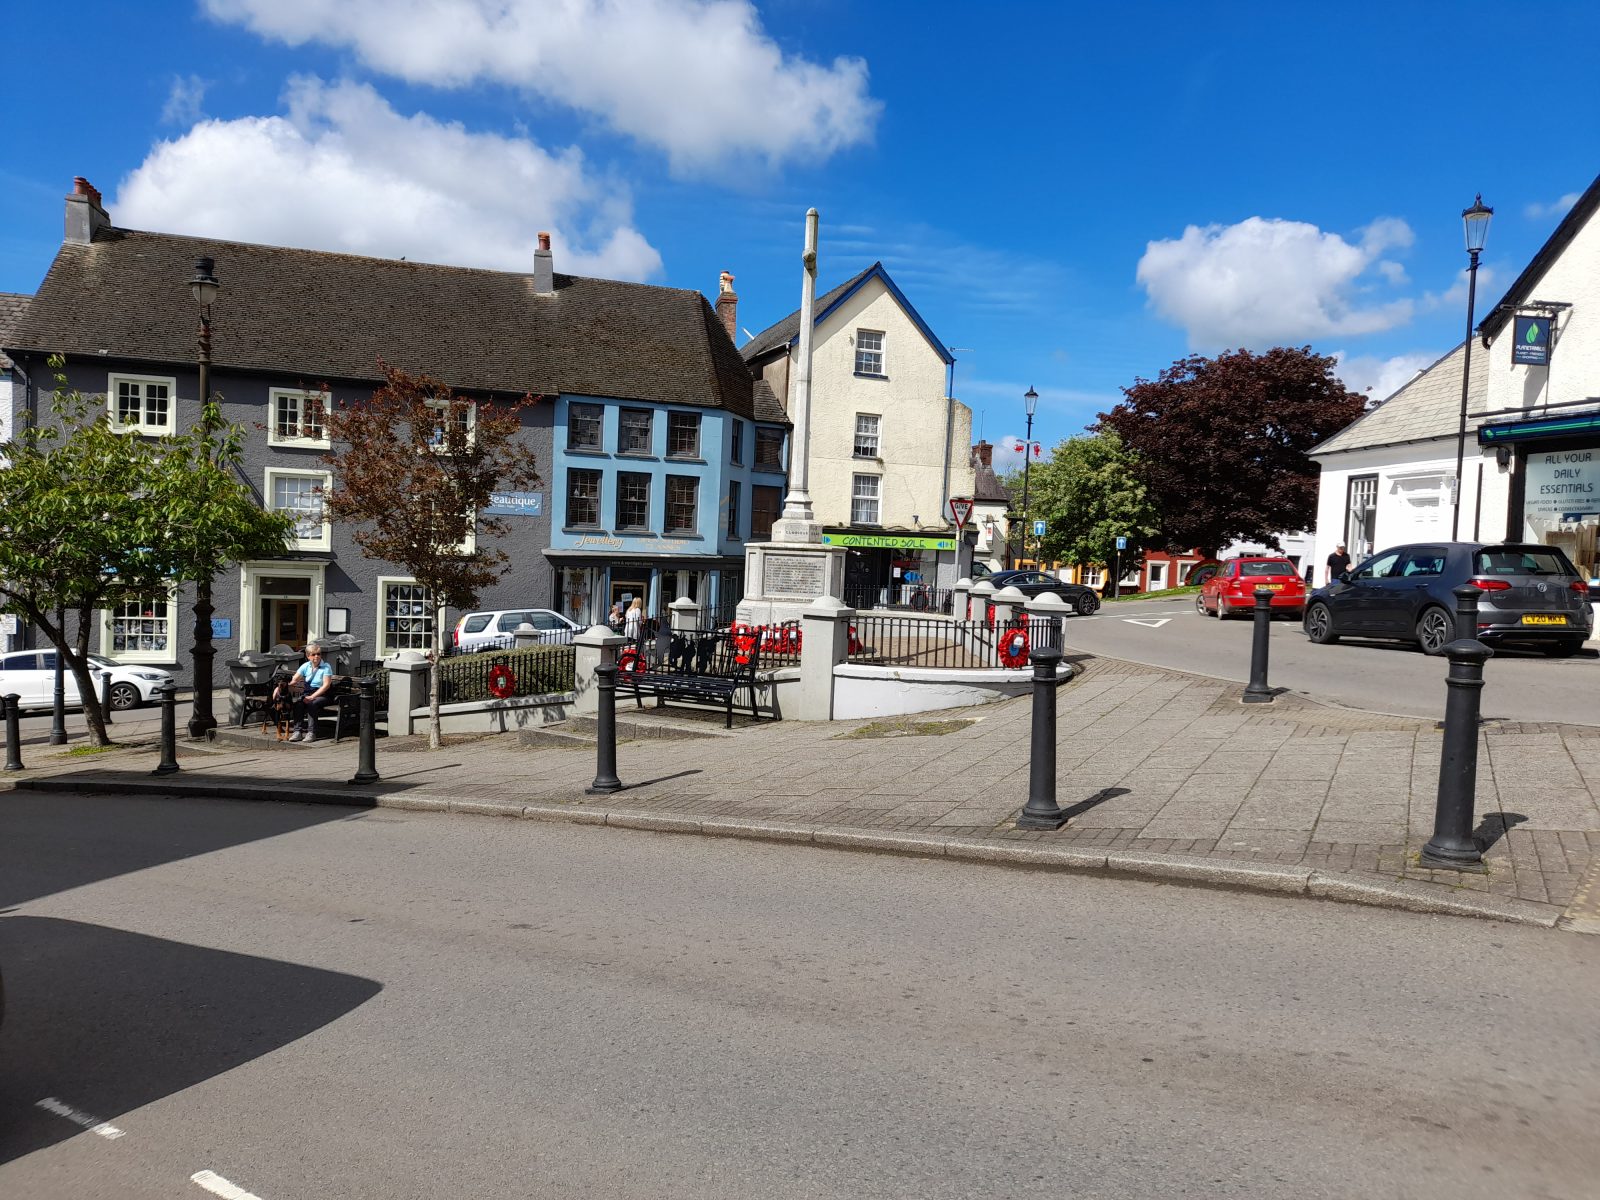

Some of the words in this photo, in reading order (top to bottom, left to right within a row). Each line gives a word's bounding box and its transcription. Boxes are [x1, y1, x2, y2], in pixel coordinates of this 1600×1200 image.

[1545, 455, 1561, 464] ALL
[1564, 453, 1592, 463] YOUR
[1554, 468, 1581, 479] DAILY
[1540, 482, 1594, 495] ESSENTIALS
[954, 502, 969, 510] GIVE
[842, 536, 898, 547] CONTENTED
[900, 539, 927, 548] SOLE
